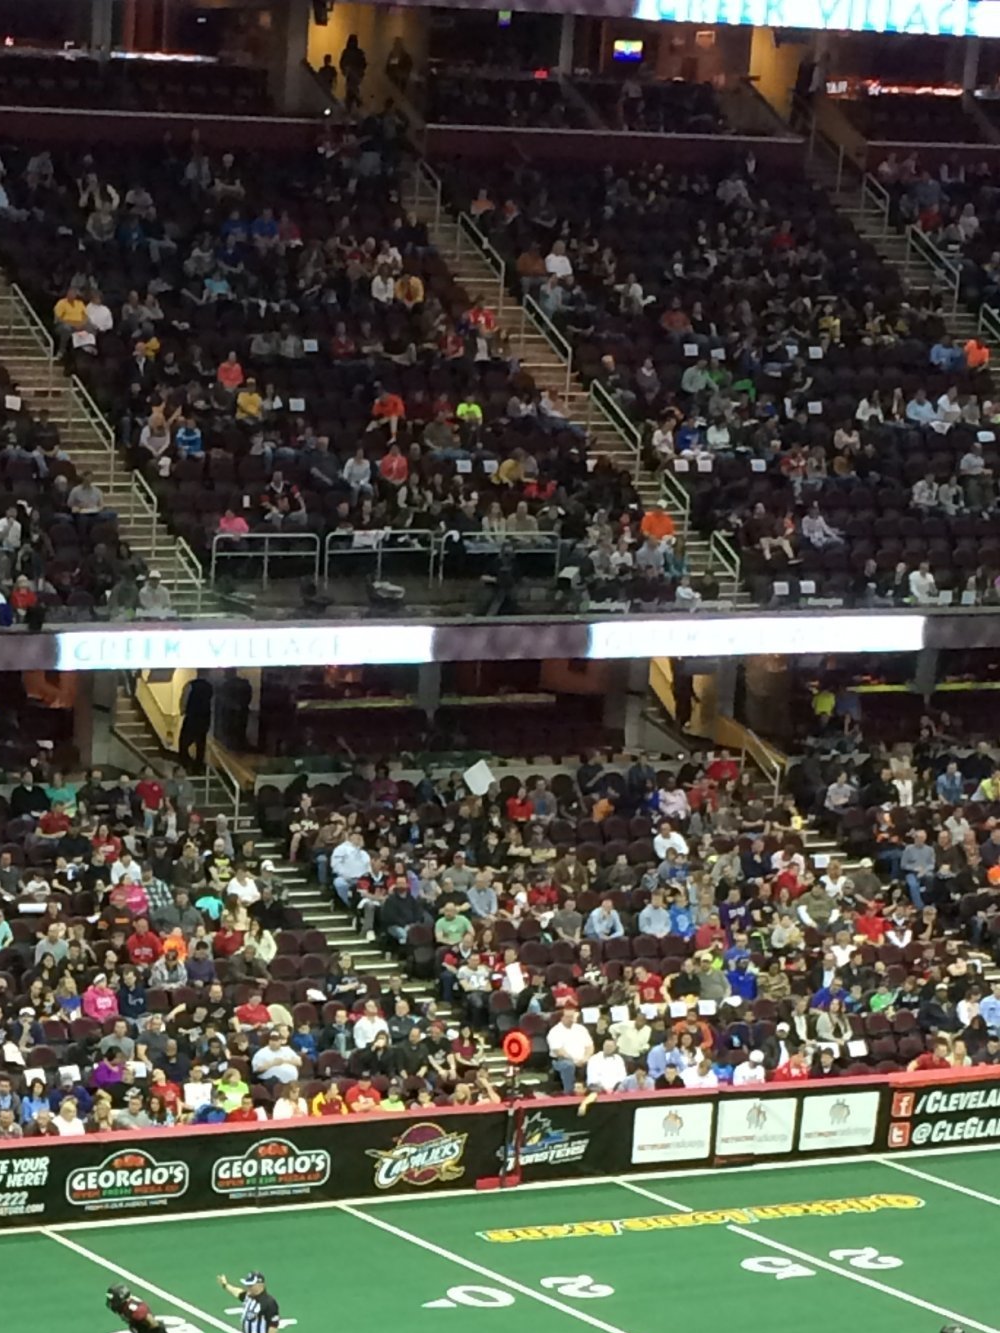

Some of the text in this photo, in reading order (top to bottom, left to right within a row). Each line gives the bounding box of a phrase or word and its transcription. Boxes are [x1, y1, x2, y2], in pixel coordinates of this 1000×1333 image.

[914, 1088, 1000, 1114] /CLEVELA
[911, 1116, 1000, 1145] @CLEGLA
[12, 1156, 50, 1173] YOUR
[217, 1154, 325, 1179] GEORGIO'S
[6, 1170, 49, 1188] HERE!
[72, 1166, 184, 1190] GEORGIO'S
[476, 1194, 925, 1243] Quicken Loans Arena
